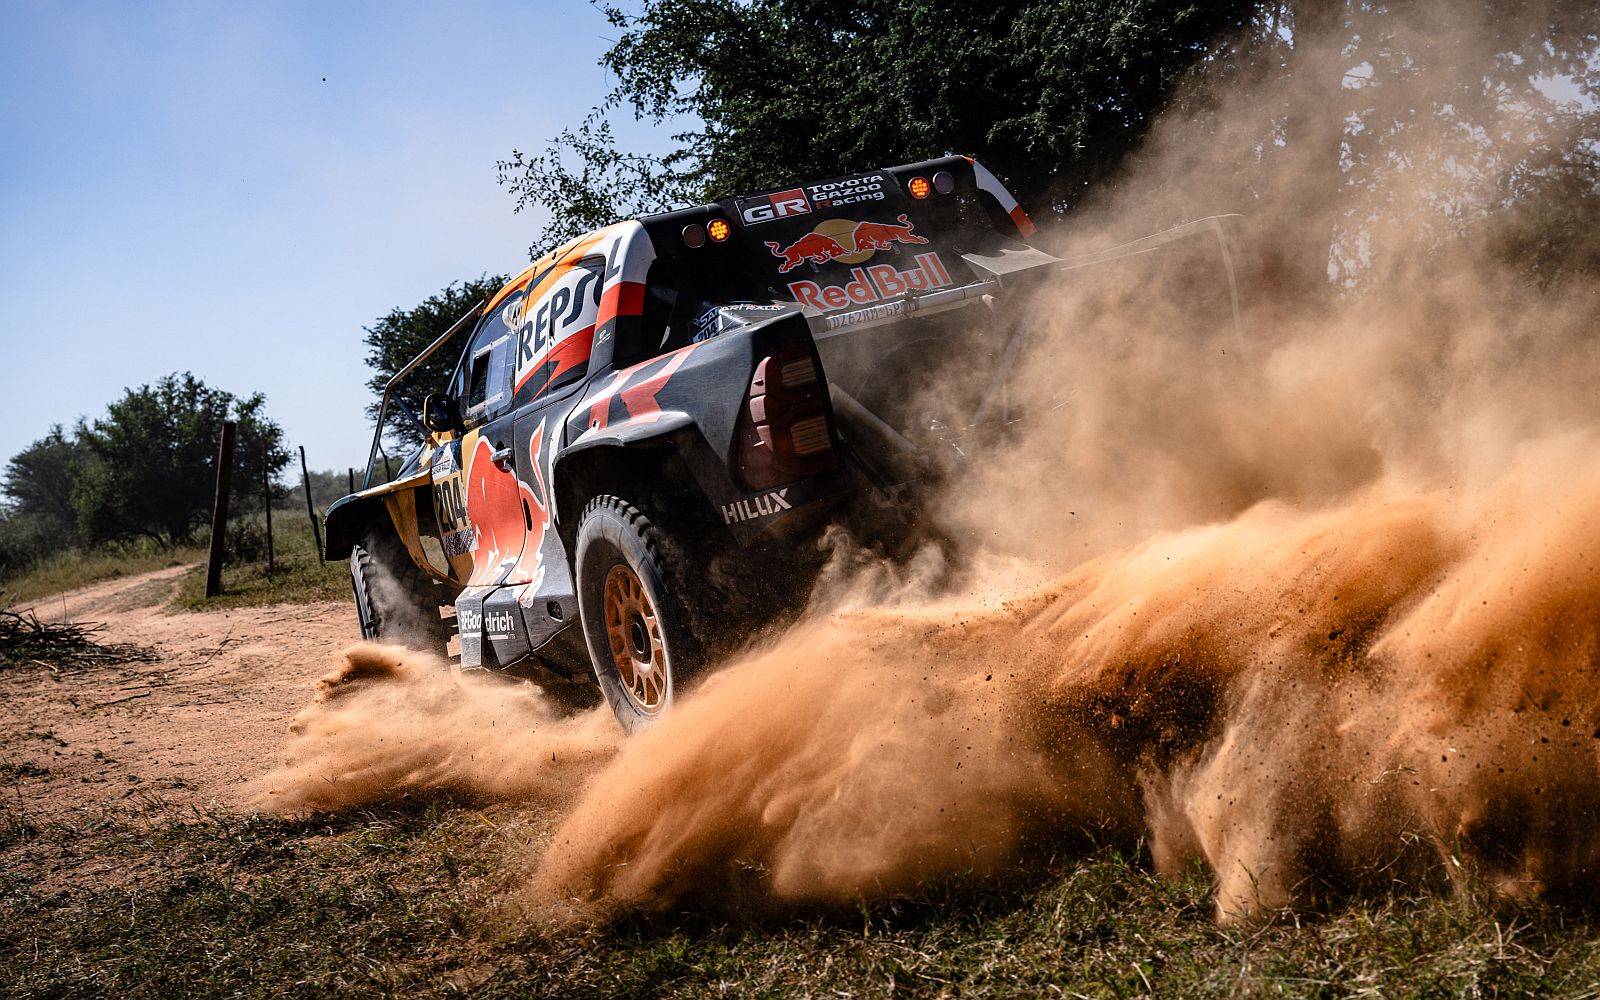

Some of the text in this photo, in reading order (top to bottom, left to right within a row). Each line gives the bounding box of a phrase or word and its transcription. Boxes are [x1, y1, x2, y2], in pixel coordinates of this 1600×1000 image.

[807, 175, 884, 193] TOYOTA
[812, 183, 882, 202] GAZOO
[743, 198, 808, 223] GR
[815, 191, 885, 209] Racing
[787, 251, 954, 313] Red Bull
[435, 477, 467, 533] 204
[721, 487, 793, 525] HILUX
[460, 609, 515, 632] BFGoodrich
